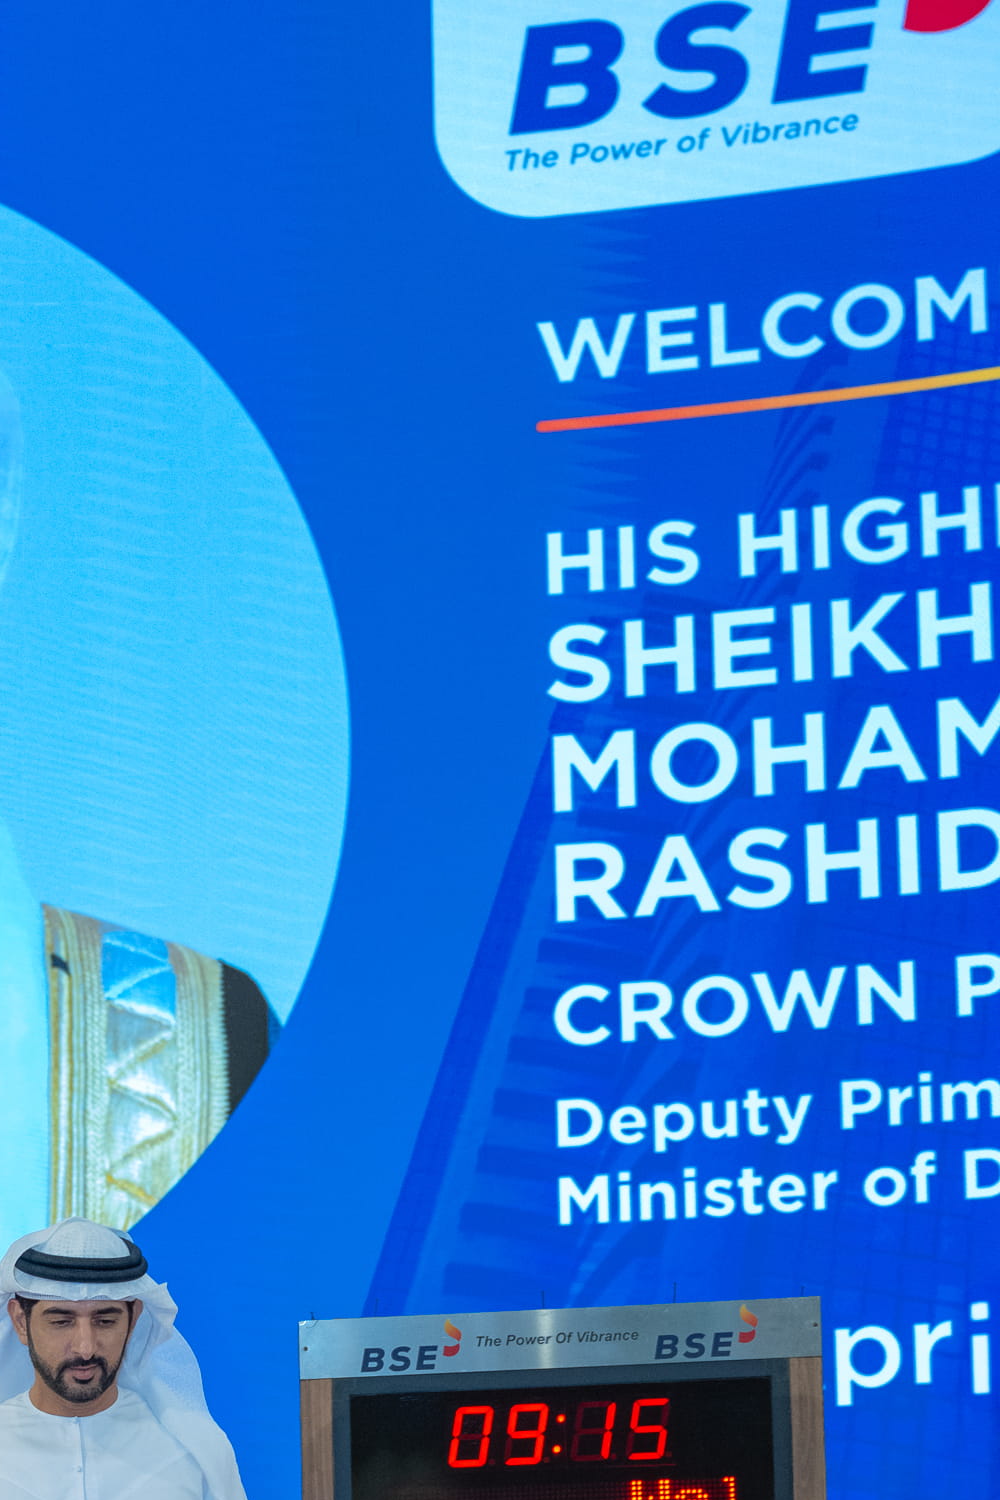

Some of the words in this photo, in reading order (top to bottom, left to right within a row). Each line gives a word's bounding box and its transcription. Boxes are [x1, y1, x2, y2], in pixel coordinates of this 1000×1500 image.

[509, 0, 878, 136] BSE
[505, 148, 559, 172] The
[570, 138, 667, 165] Power
[676, 128, 712, 154] of
[721, 113, 859, 148] Vibrance
[536, 267, 988, 383] WELCOM
[546, 519, 700, 596] HIS
[738, 482, 1000, 578] HIGH
[546, 581, 994, 703] SHEIKH
[552, 696, 1000, 814] MOHAM
[554, 807, 1000, 923] RASHID
[553, 960, 917, 1047] CROWN
[955, 953, 1000, 1017] P
[556, 1088, 813, 1153] Deputy
[840, 1071, 1000, 1130] Prim
[558, 1166, 839, 1226] Minister
[863, 1150, 937, 1207] of
[361, 1345, 438, 1373] BSE
[475, 1335, 502, 1348] The
[505, 1334, 552, 1347] Power
[555, 1332, 574, 1345] Of
[576, 1330, 640, 1344] Vibrance
[654, 1331, 735, 1360] BSE
[447, 1397, 670, 1468] 09:15
